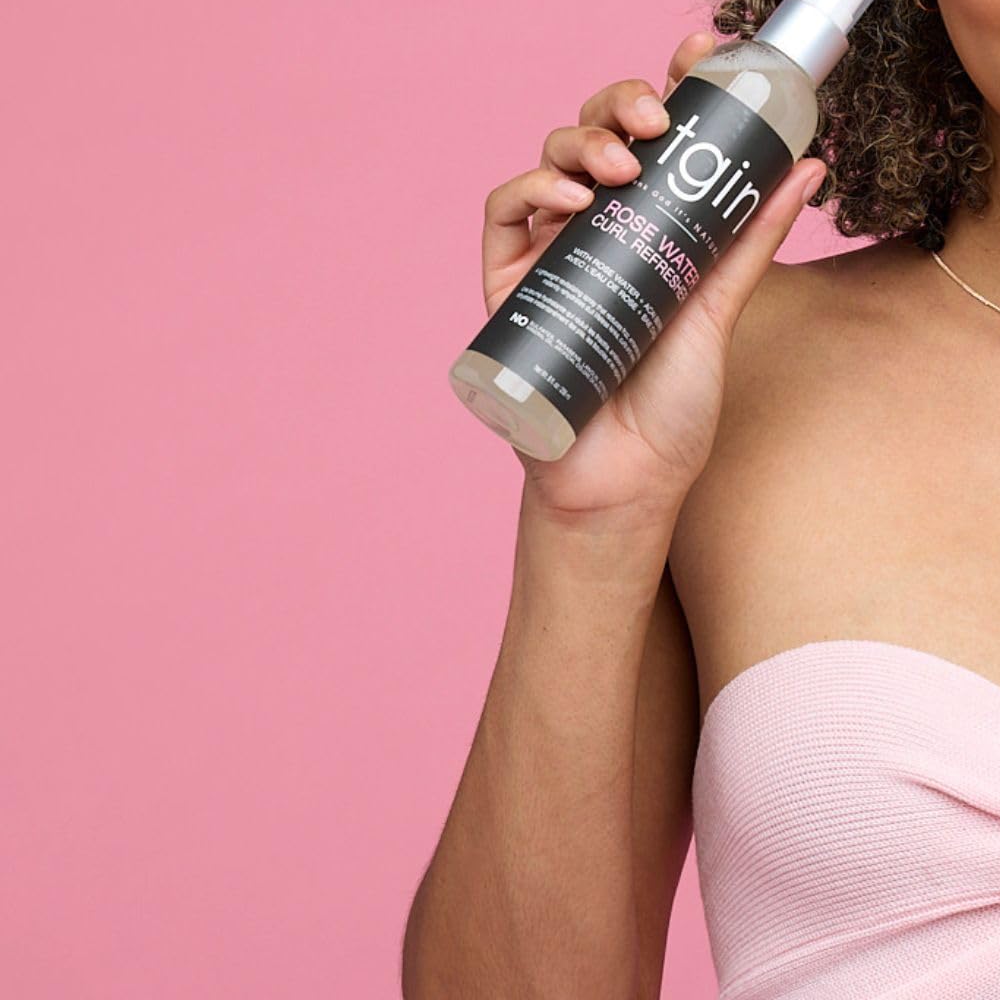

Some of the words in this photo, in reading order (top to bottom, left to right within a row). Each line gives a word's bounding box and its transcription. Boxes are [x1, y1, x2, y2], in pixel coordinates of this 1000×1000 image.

[656, 115, 761, 234] tgin
[650, 189, 672, 207] God
[592, 214, 631, 244] CURL
[604, 200, 659, 241] ROSE
[564, 253, 587, 269] AVEC
[605, 279, 620, 293] DE
[617, 288, 639, 311] ROSE
[572, 246, 593, 262] WITH
[590, 258, 615, 278] ROSE
[612, 273, 641, 299] WATER
[508, 311, 530, 328] NO
